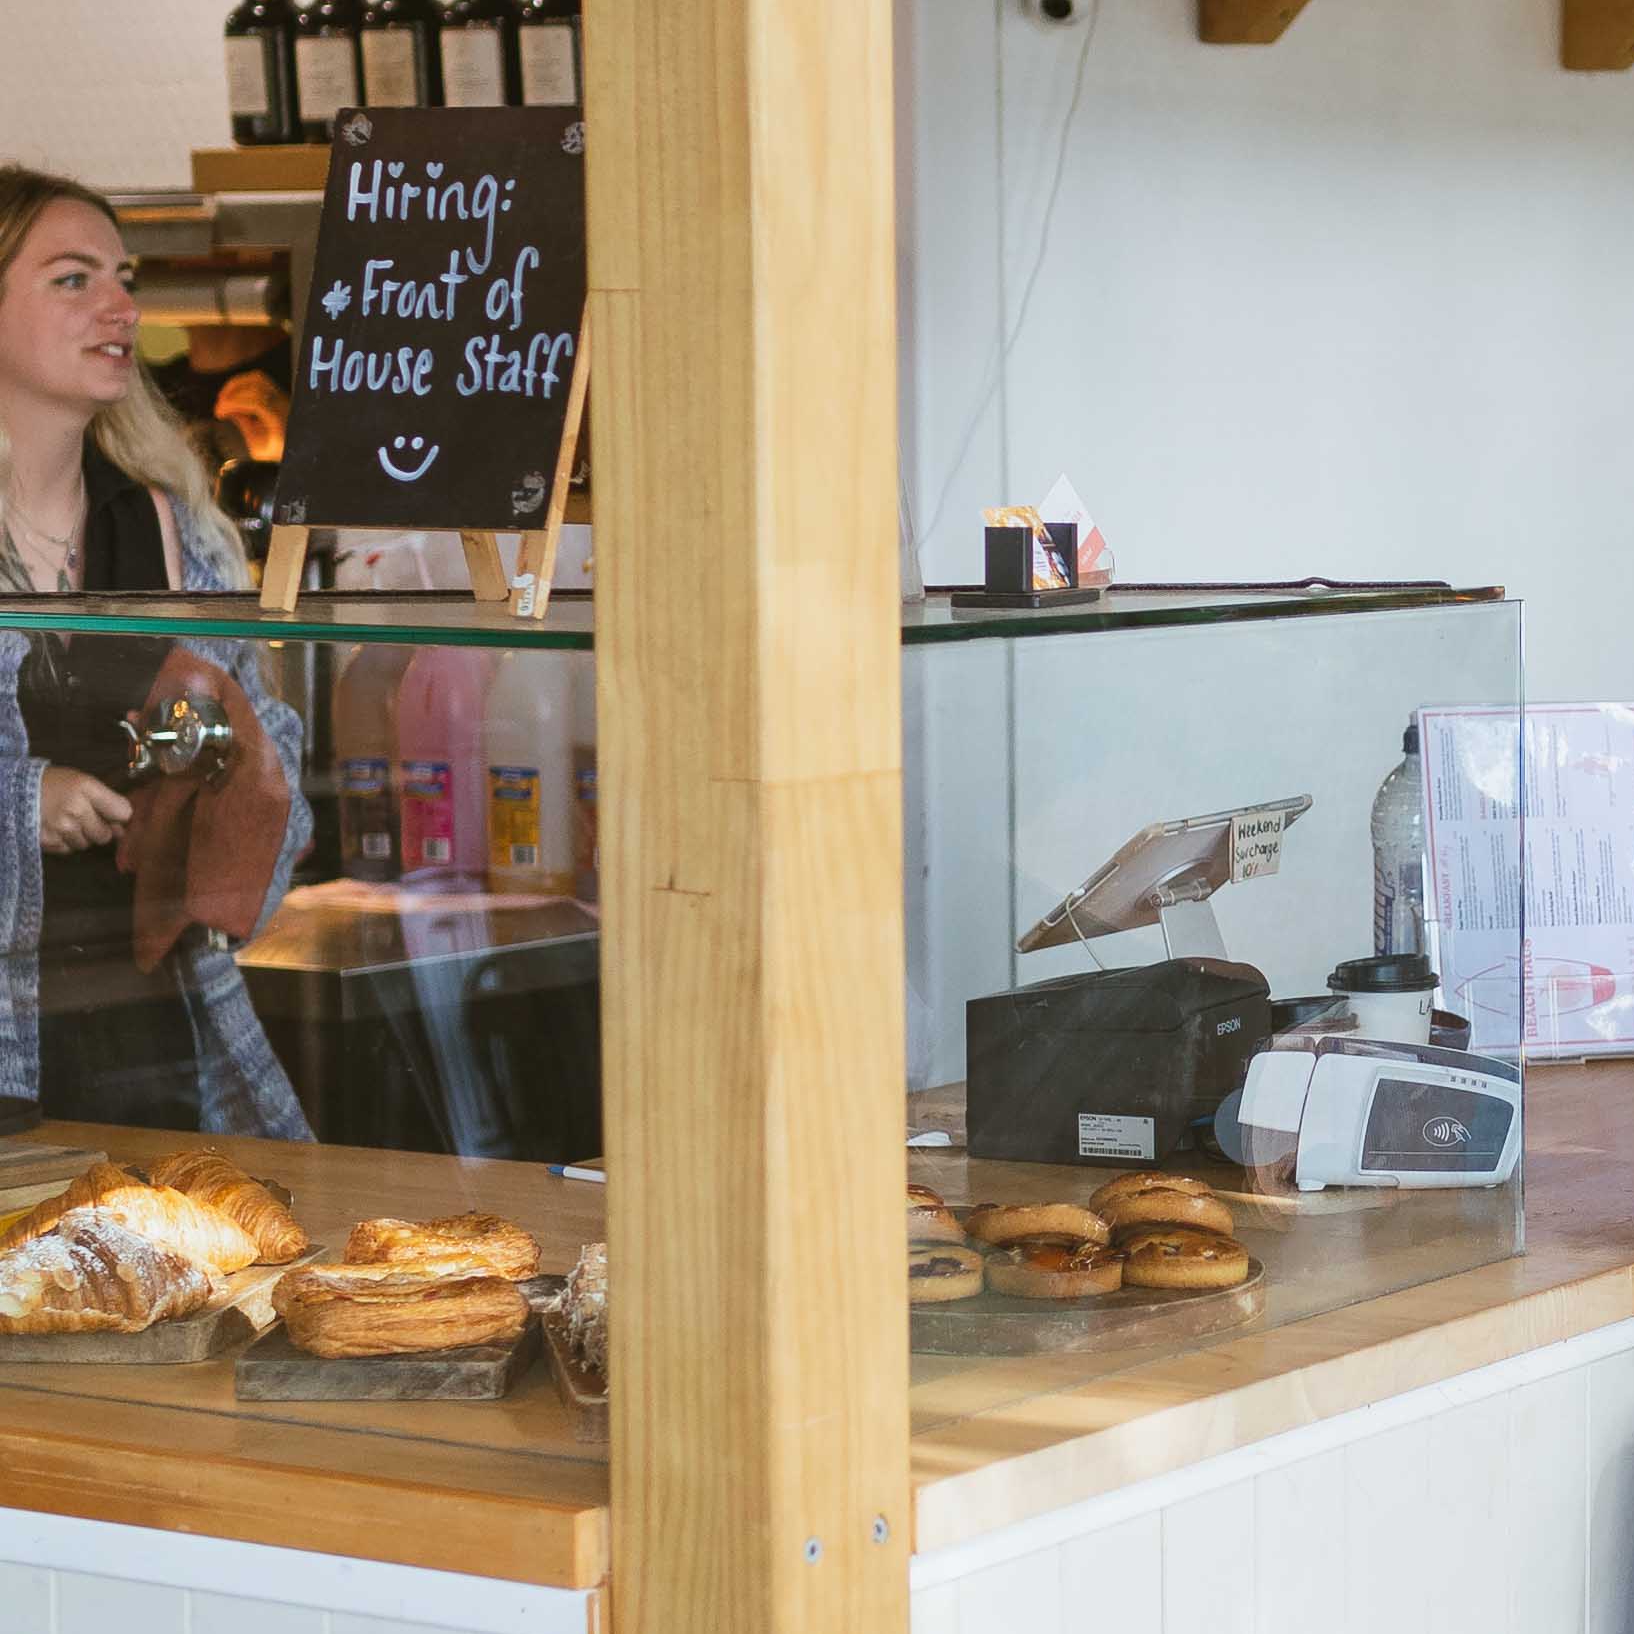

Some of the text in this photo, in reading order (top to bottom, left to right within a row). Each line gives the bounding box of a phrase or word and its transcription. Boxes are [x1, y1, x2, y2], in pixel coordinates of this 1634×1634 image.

[346, 159, 516, 275] Hiring:
[361, 245, 539, 330] Front of
[309, 332, 573, 399] House Staff
[1236, 842, 1279, 864] Surcharge
[1238, 816, 1281, 841] Weekend
[1217, 1015, 1241, 1036] EPSON
[1525, 985, 1538, 1038] BEACH
